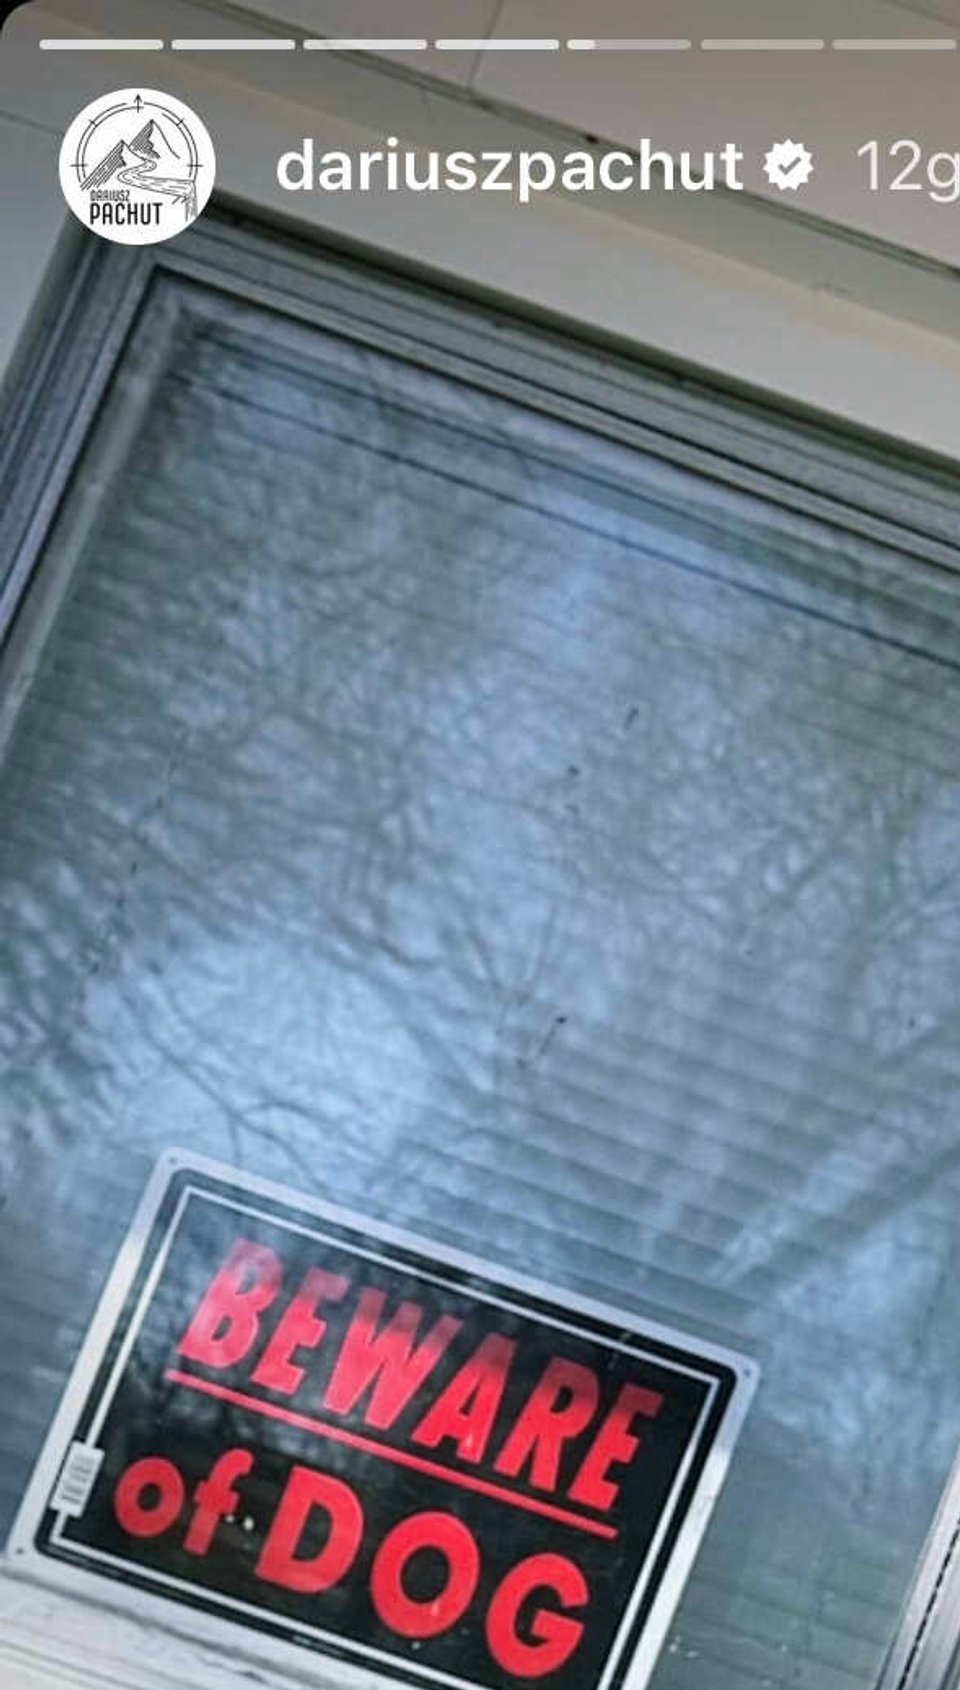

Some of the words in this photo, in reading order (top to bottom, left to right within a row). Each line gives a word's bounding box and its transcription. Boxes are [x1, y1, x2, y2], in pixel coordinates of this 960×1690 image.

[178, 1237, 662, 1511] BEWARE
[115, 1449, 254, 1555] of
[255, 1466, 589, 1678] DOG
